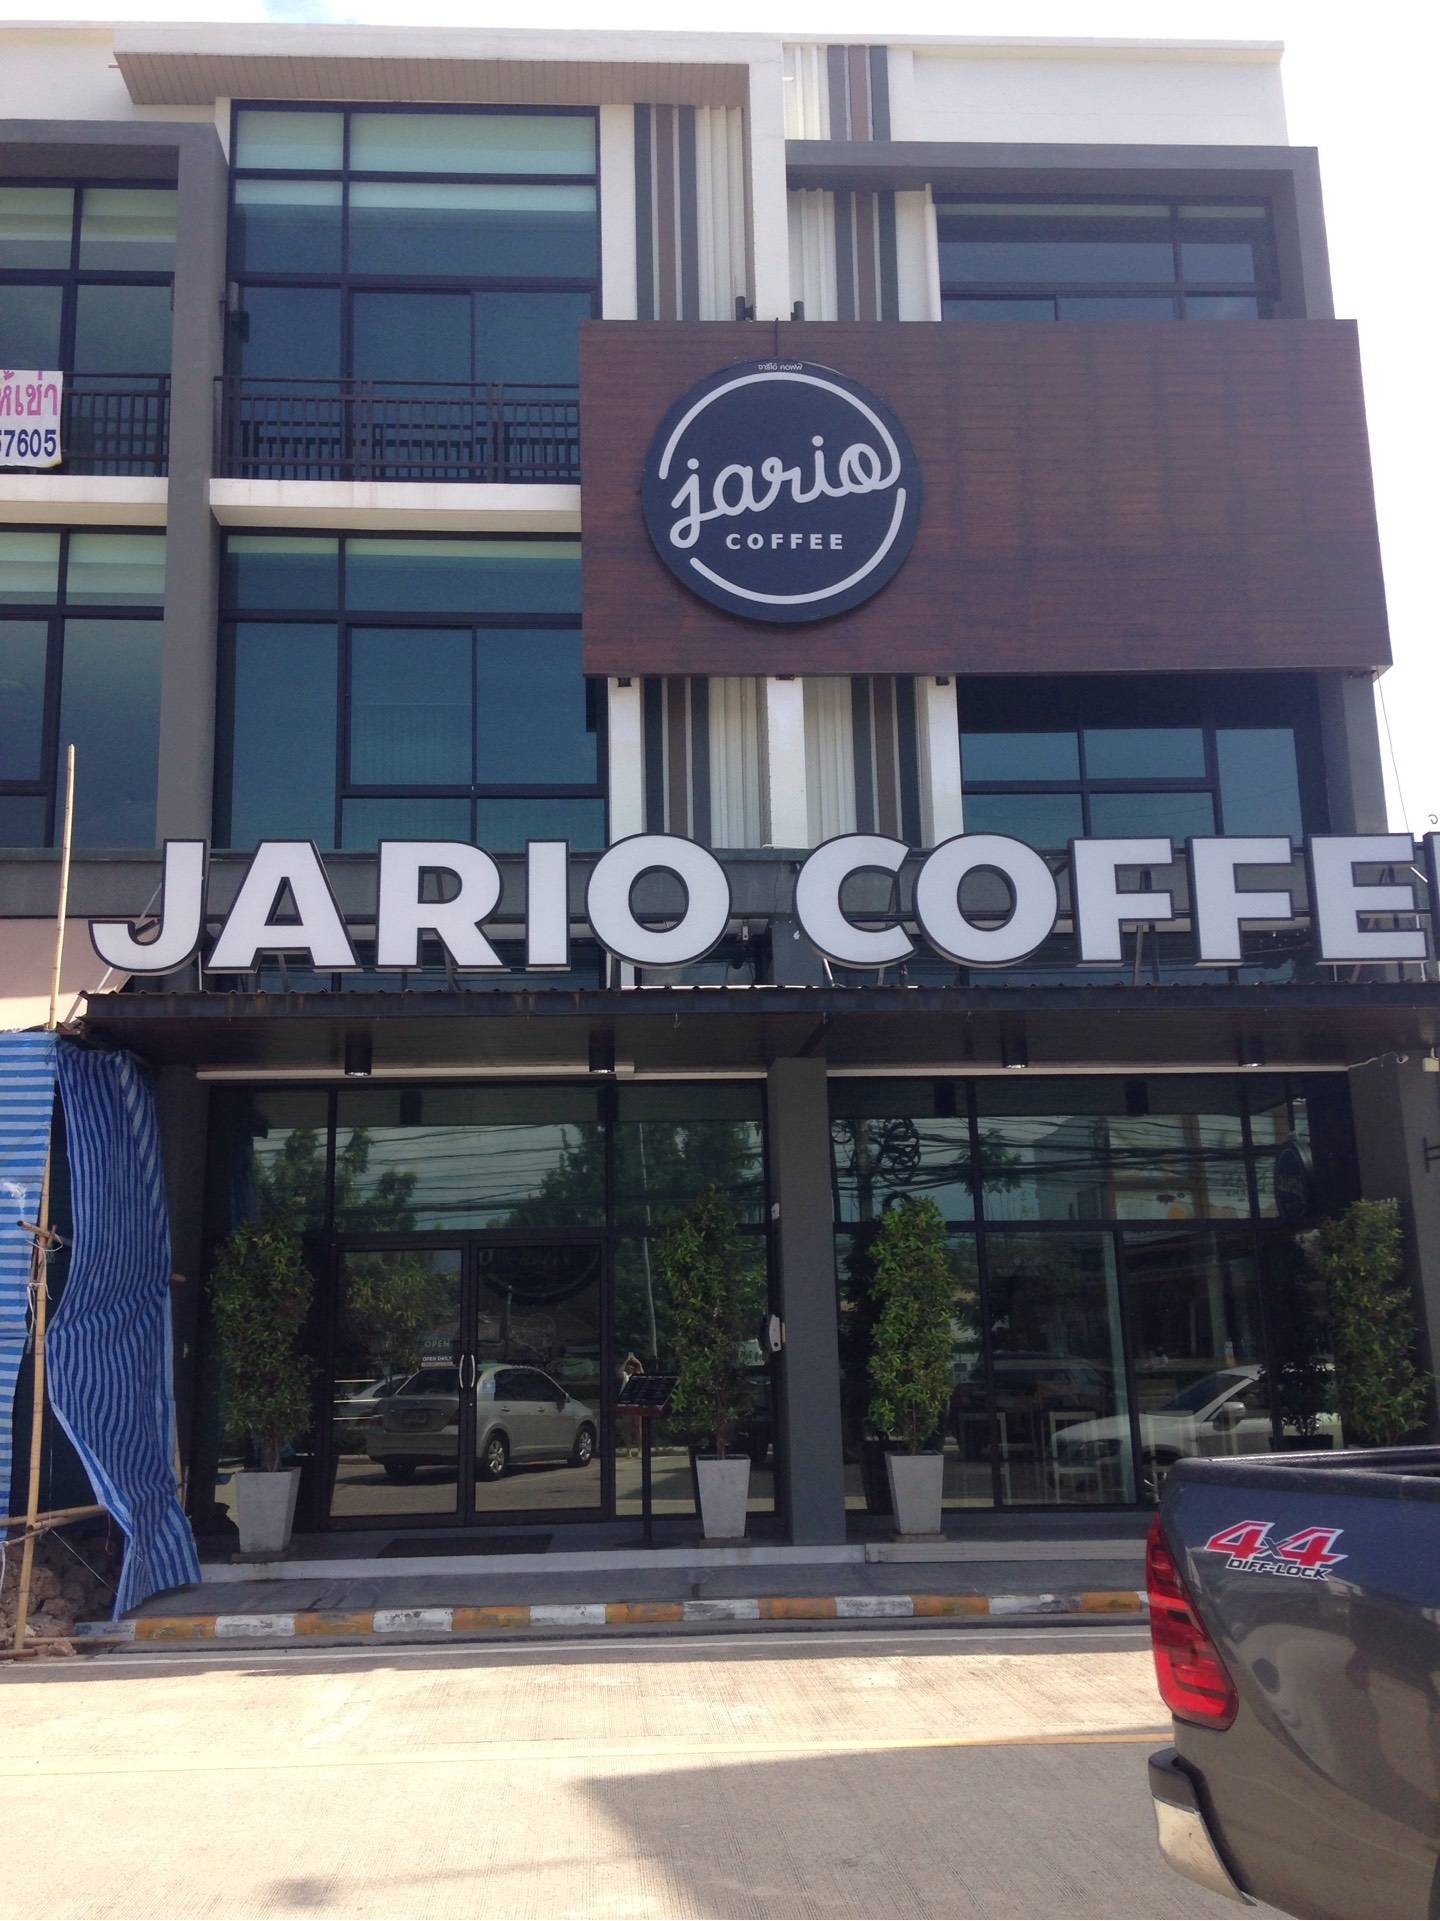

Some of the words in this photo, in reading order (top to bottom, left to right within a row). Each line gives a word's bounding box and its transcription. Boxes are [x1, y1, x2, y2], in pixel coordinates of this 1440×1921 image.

[725, 533, 843, 550] COFFEE
[88, 833, 733, 974] JARIO
[794, 831, 1440, 969] COFFE
[1226, 1557, 1332, 1581] DIFF-LOCK
